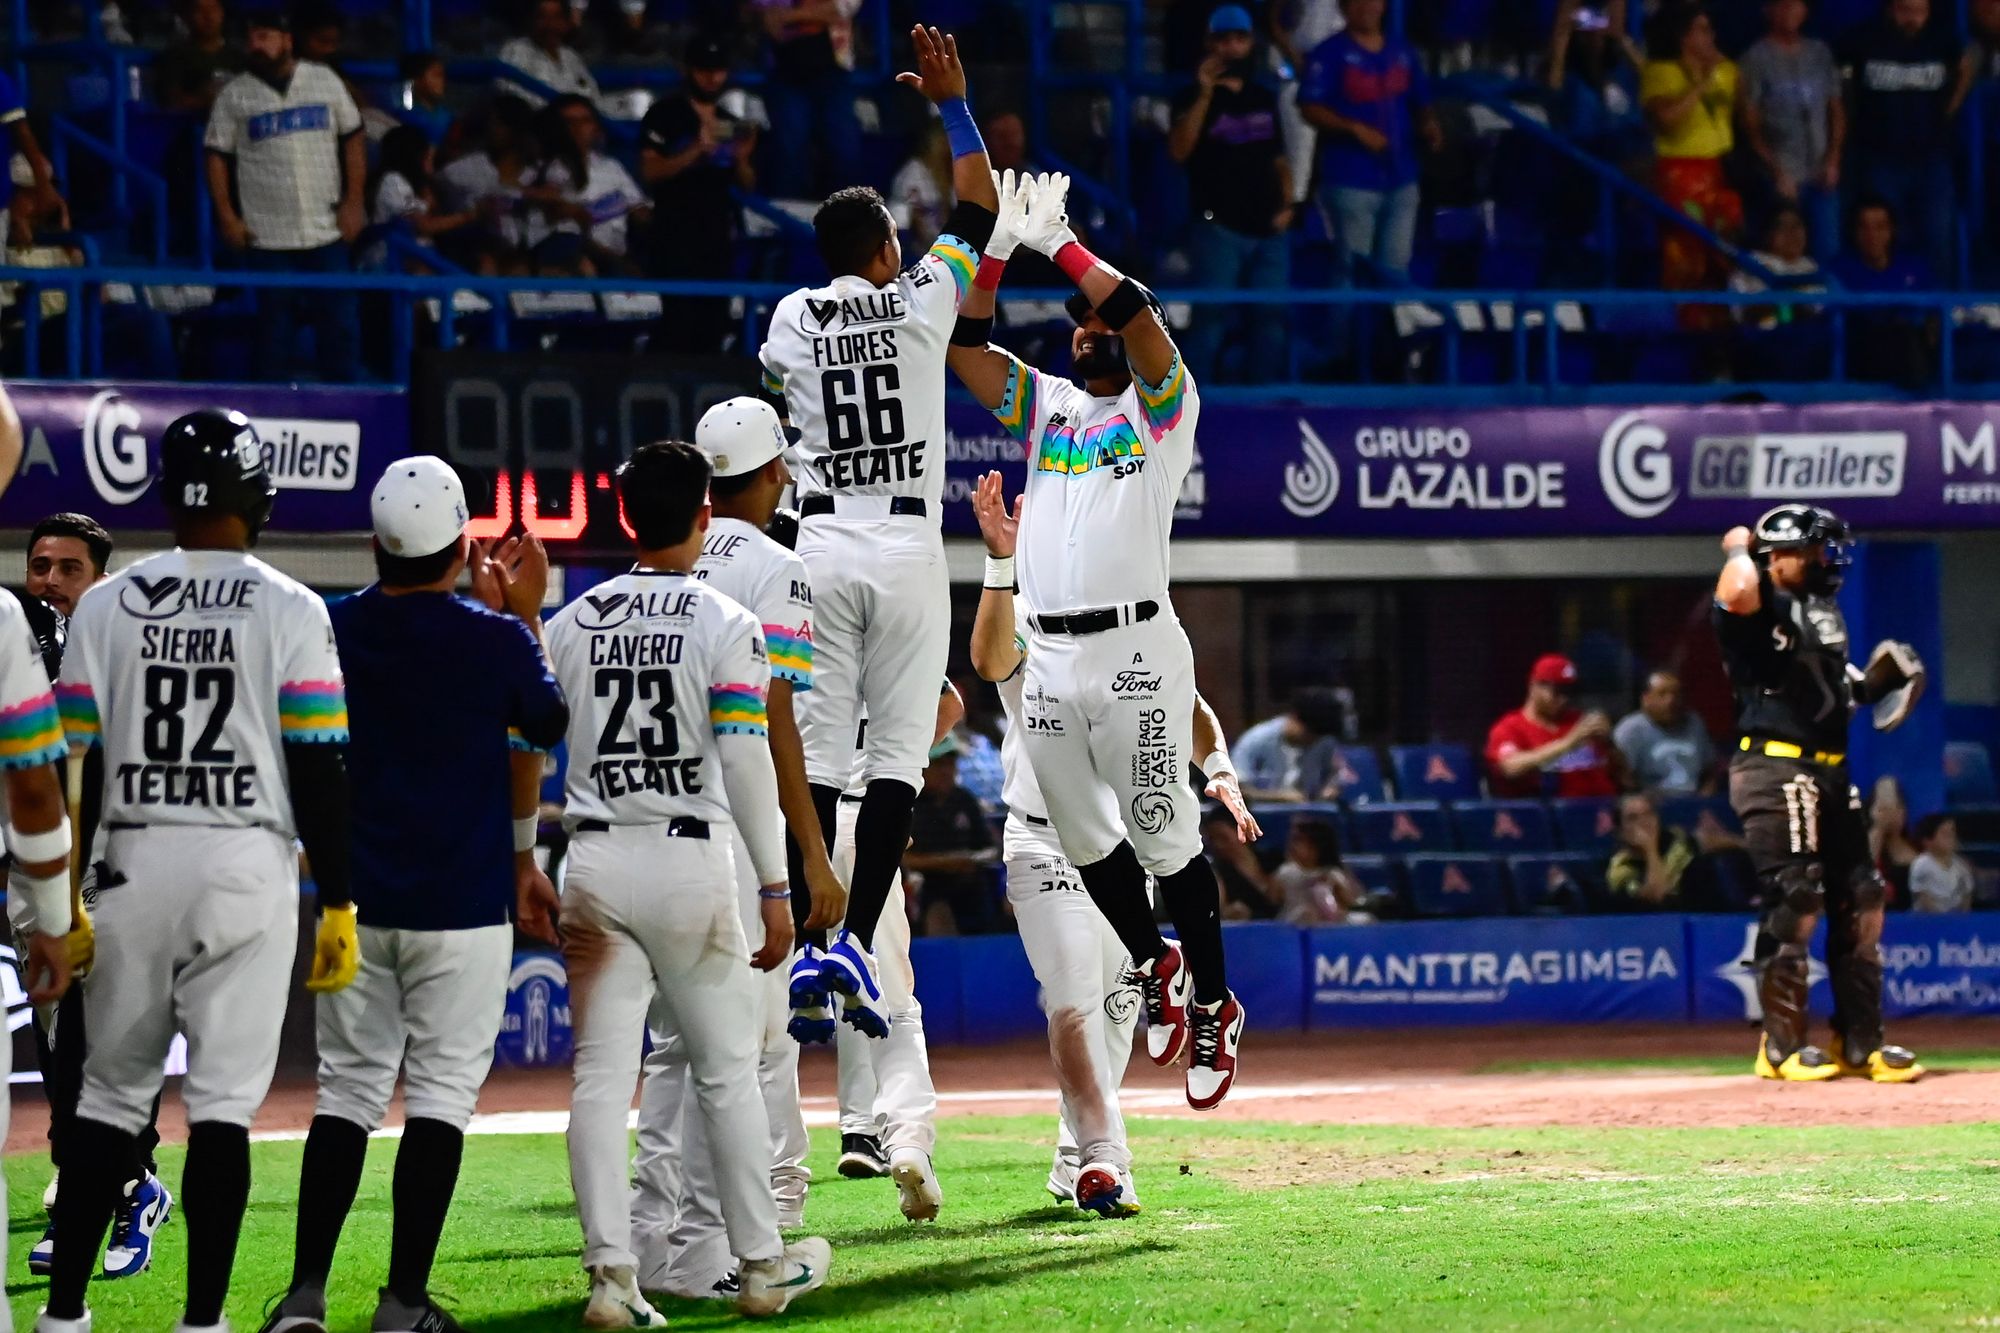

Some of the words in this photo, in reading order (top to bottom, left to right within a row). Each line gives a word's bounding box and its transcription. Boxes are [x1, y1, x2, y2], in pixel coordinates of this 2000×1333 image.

[805, 293, 905, 331] VALUE
[813, 329, 898, 368] FLORES
[821, 363, 905, 451] 66
[1049, 411, 1068, 427] DE
[263, 431, 352, 480] ailers
[1355, 427, 1471, 458] GRUPO
[813, 439, 927, 489] TECATE
[1113, 459, 1146, 480] SOY
[1699, 444, 1750, 490] GG
[1762, 444, 1896, 489] Trailers
[1358, 463, 1566, 508] LAZALDE
[701, 533, 750, 558] LUE
[128, 575, 261, 611] VALUE
[584, 591, 699, 623] VALUE
[141, 624, 236, 663] SIERRA
[590, 634, 684, 667] CAVERO
[1111, 670, 1163, 692] Ford
[144, 664, 236, 763] 82
[594, 668, 680, 758] 23
[1027, 716, 1064, 732] JAC
[1138, 709, 1151, 748] EAGLE
[1150, 708, 1167, 788] CASINO
[1168, 742, 1178, 784] HOTEL
[116, 763, 257, 807] TECATE
[588, 757, 704, 802] TECATE
[1138, 750, 1151, 788] LUCKY
[1314, 947, 1678, 987] MANTTRAGIMSA
